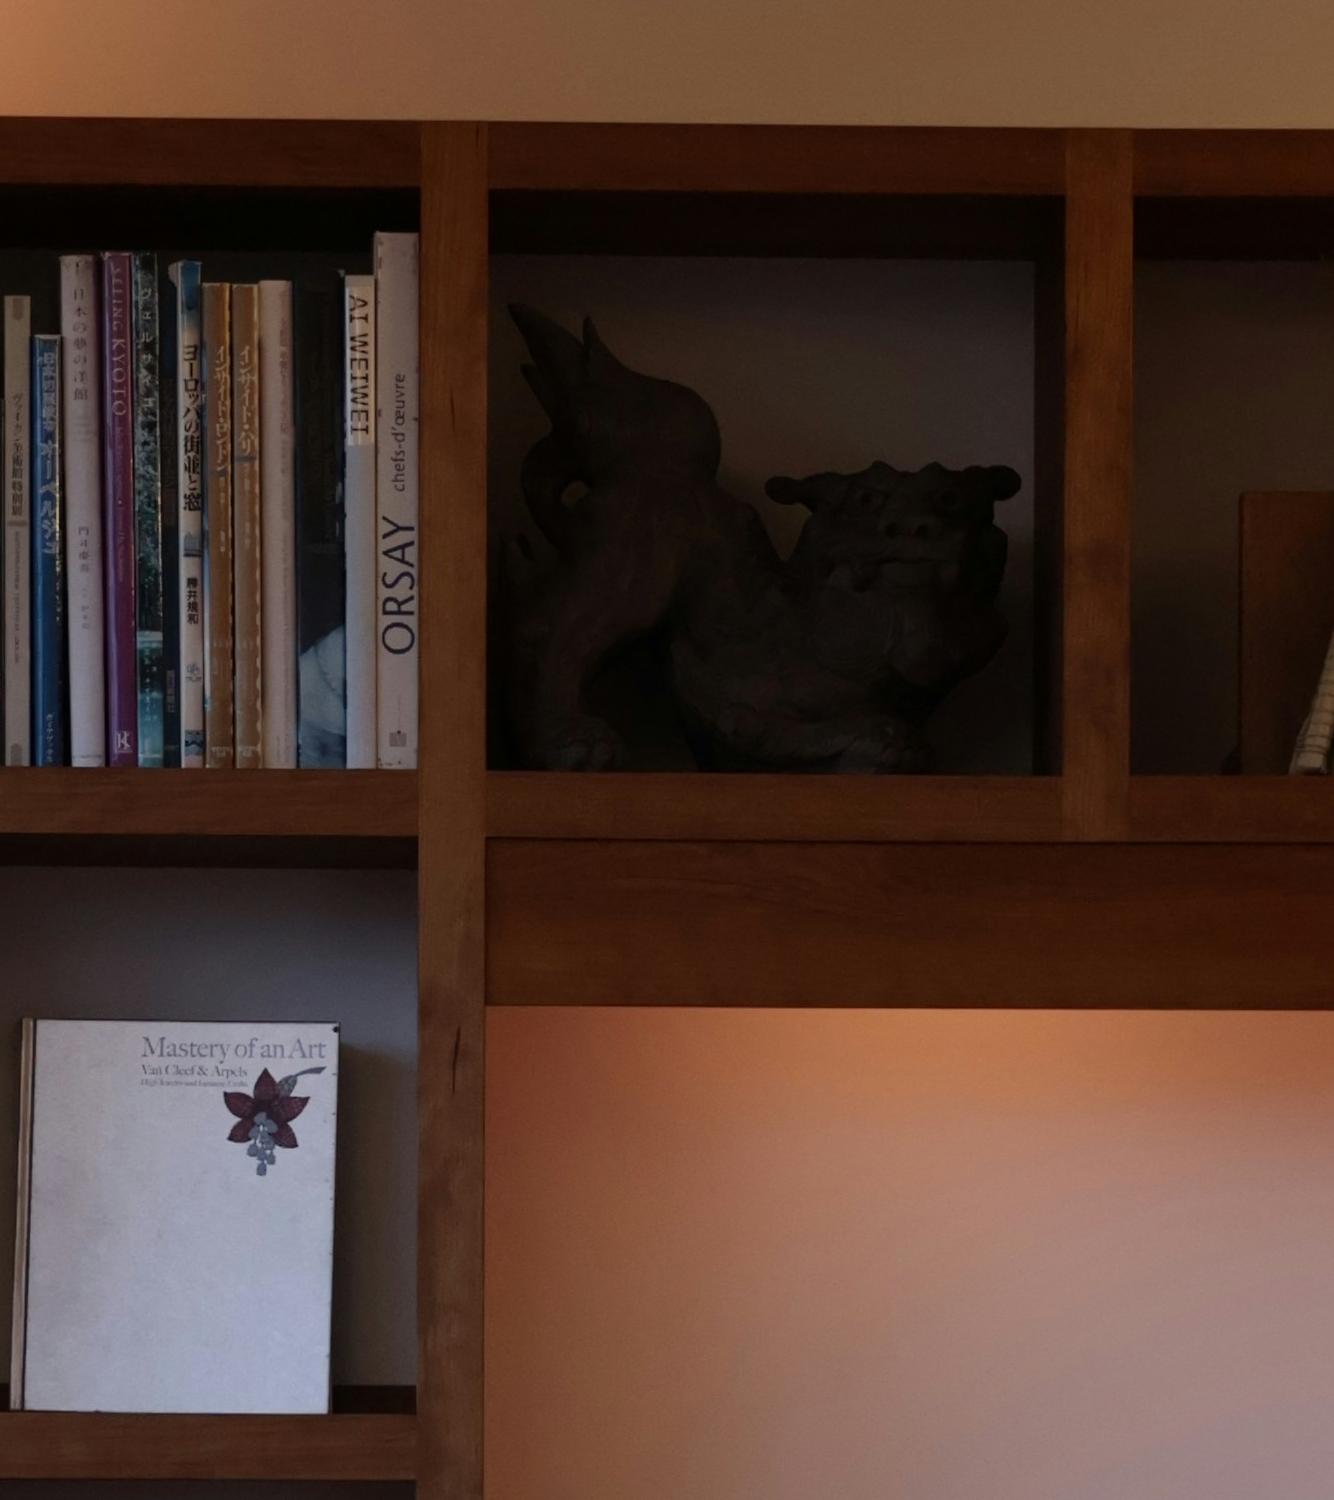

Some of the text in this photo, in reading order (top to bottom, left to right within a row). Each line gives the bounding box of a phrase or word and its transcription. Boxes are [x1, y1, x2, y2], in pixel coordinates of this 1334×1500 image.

[111, 338, 127, 417] KYOTO
[350, 294, 371, 437] AI WEIWEI
[182, 344, 202, 512] ヨーロッパの街並と窓
[382, 515, 416, 656] ORSAY
[141, 1036, 327, 1064] Mastery of an Art
[142, 1064, 248, 1079] Van Cleef & Arpels
